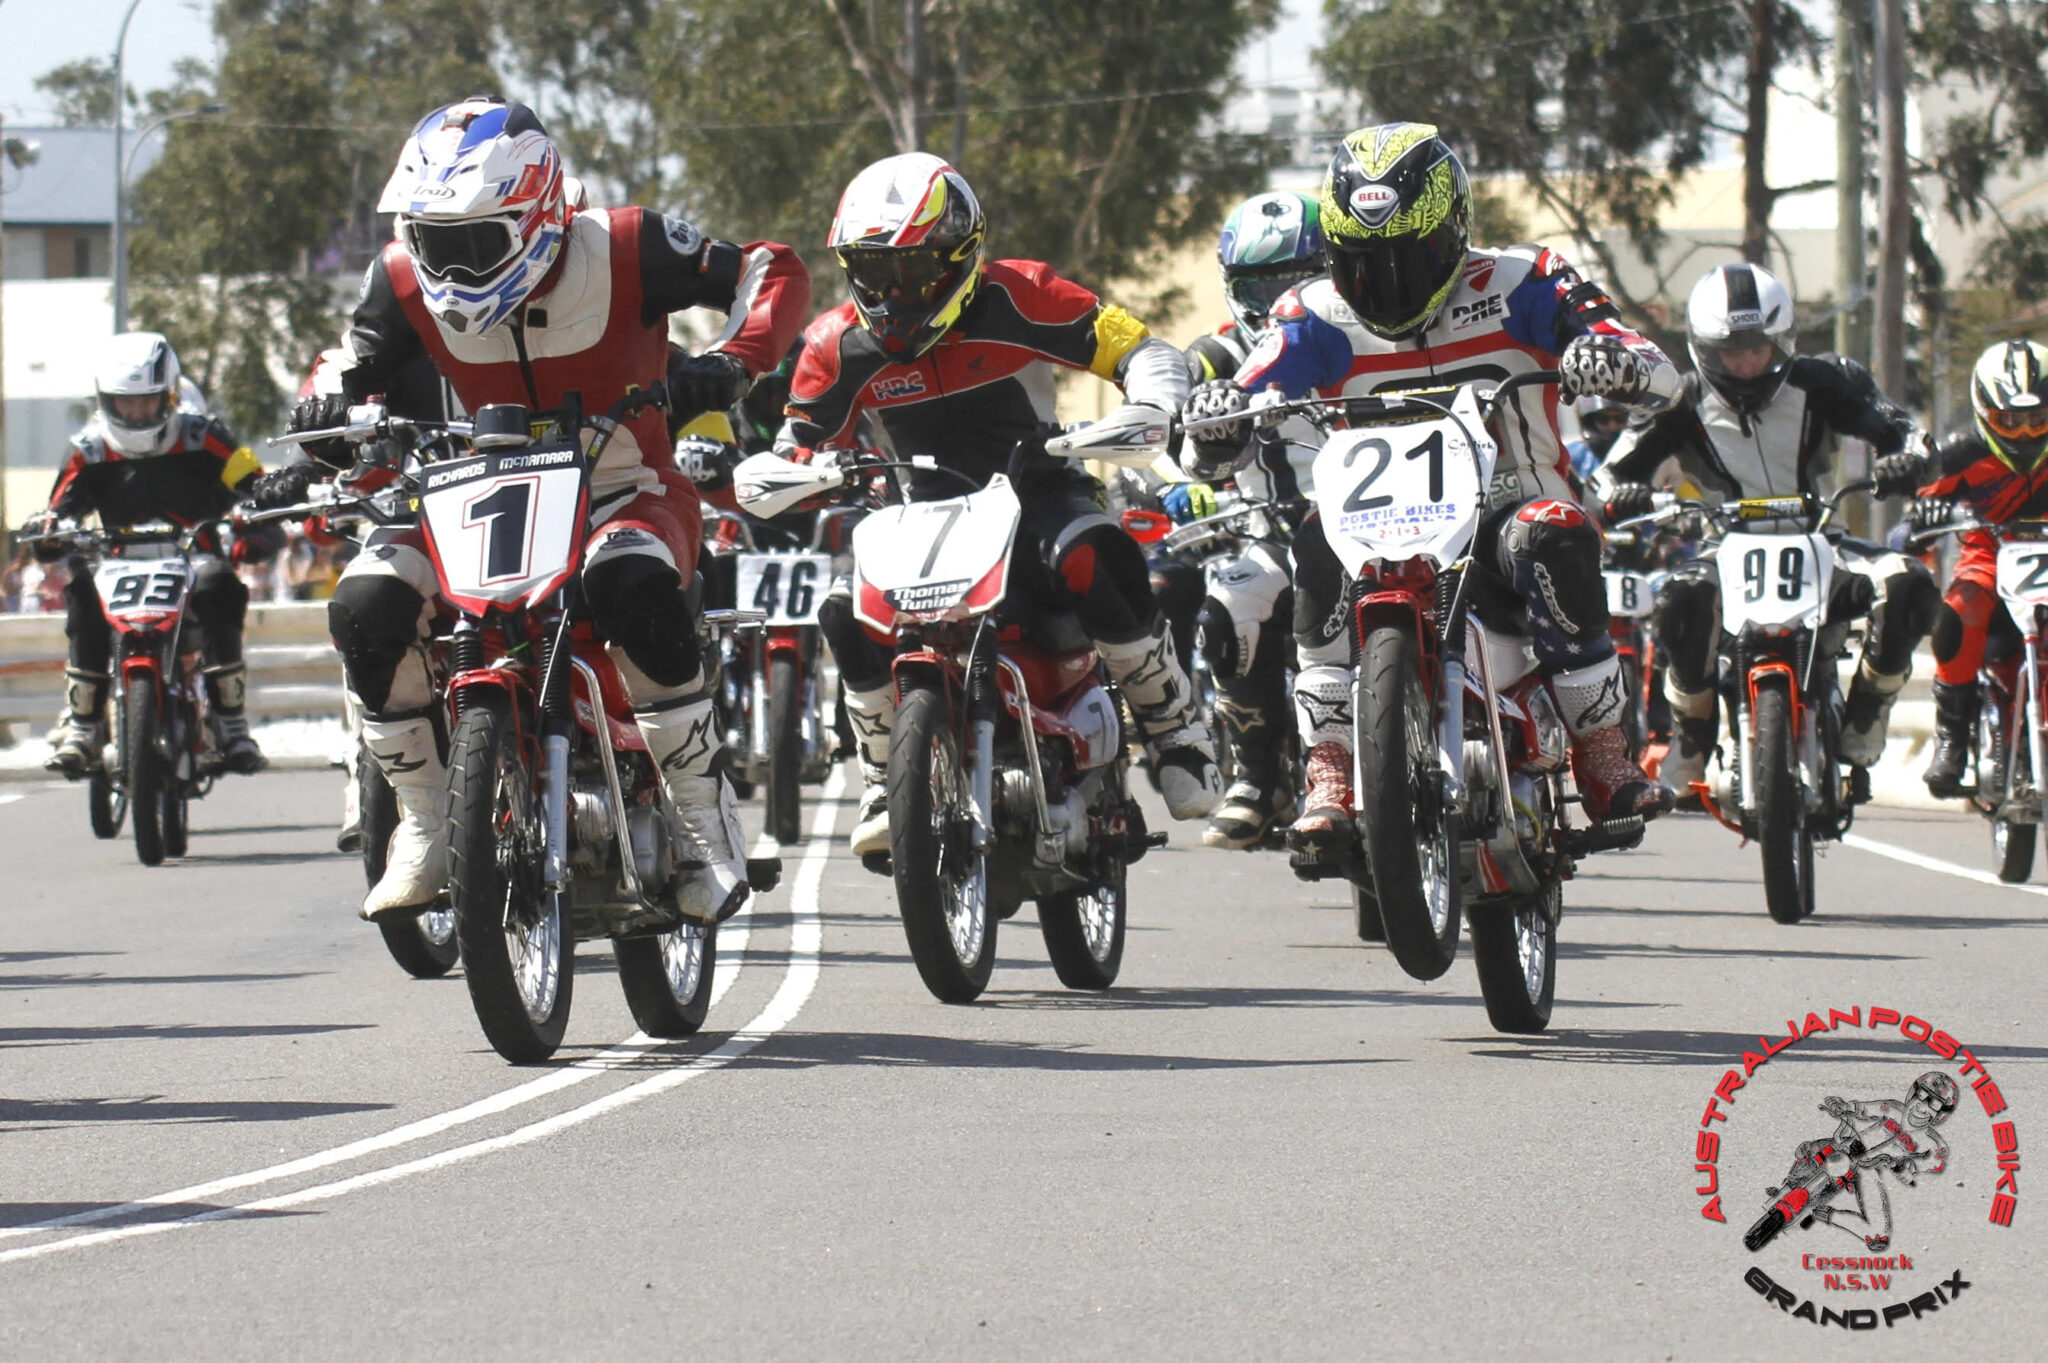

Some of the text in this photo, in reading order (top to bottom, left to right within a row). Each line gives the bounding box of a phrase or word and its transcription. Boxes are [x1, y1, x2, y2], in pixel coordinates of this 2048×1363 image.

[1358, 191, 1389, 202] BELL
[1452, 293, 1503, 325] DRE
[870, 370, 927, 401] HRC
[427, 462, 487, 489] RICHARDS
[1342, 429, 1444, 513] 21
[1339, 507, 1399, 526] POSTIE
[1405, 503, 1456, 516] BIKES
[468, 481, 534, 581] 1
[919, 503, 964, 579] 7
[753, 561, 818, 620] 46
[893, 581, 971, 601] Thomas
[1743, 547, 1804, 604] 99
[108, 573, 186, 612] 93
